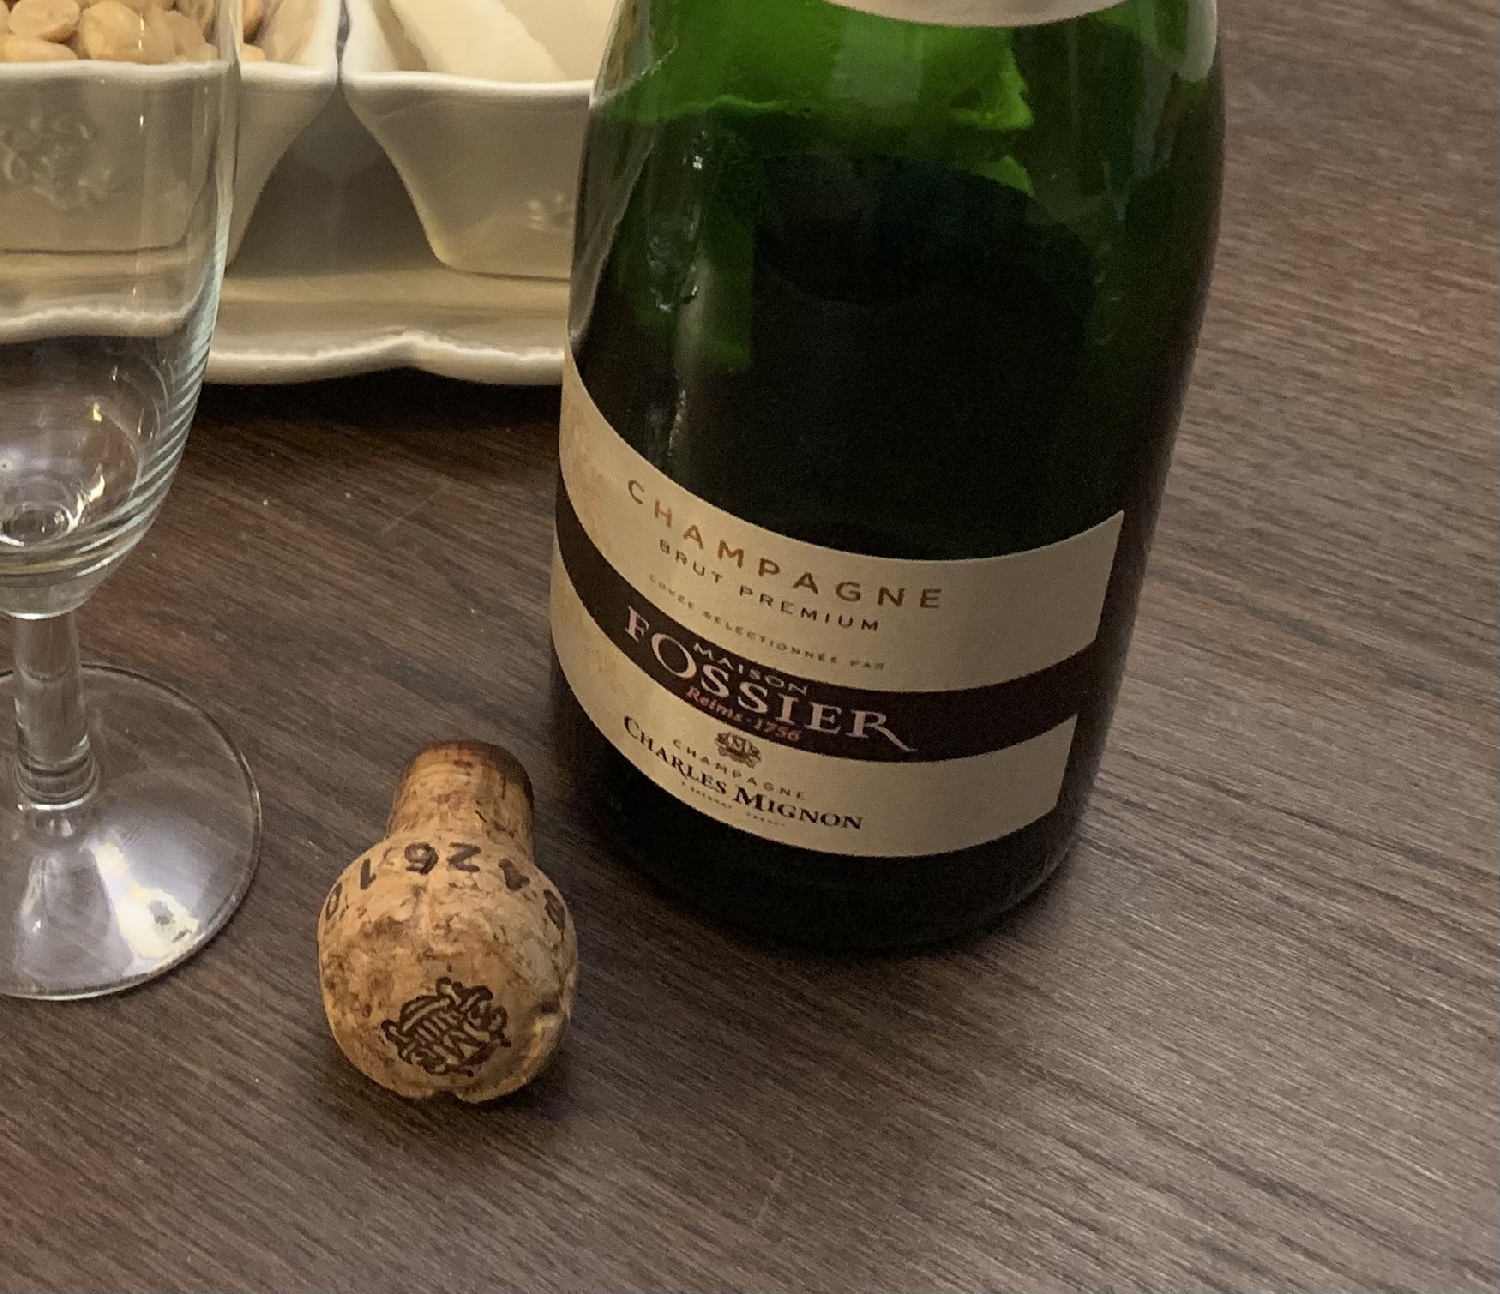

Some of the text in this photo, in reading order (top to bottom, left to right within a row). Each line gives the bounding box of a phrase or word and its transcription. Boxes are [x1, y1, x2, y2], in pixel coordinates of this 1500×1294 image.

[627, 478, 943, 610] CHAMPAGNE
[659, 538, 880, 632] BRUT PREMIUM
[623, 606, 918, 753] FOSSIER
[692, 641, 809, 696] MAISON
[623, 714, 728, 796] CHARLES
[732, 784, 864, 832] MIGNON
[672, 737, 806, 802] CHAMPAGNE
